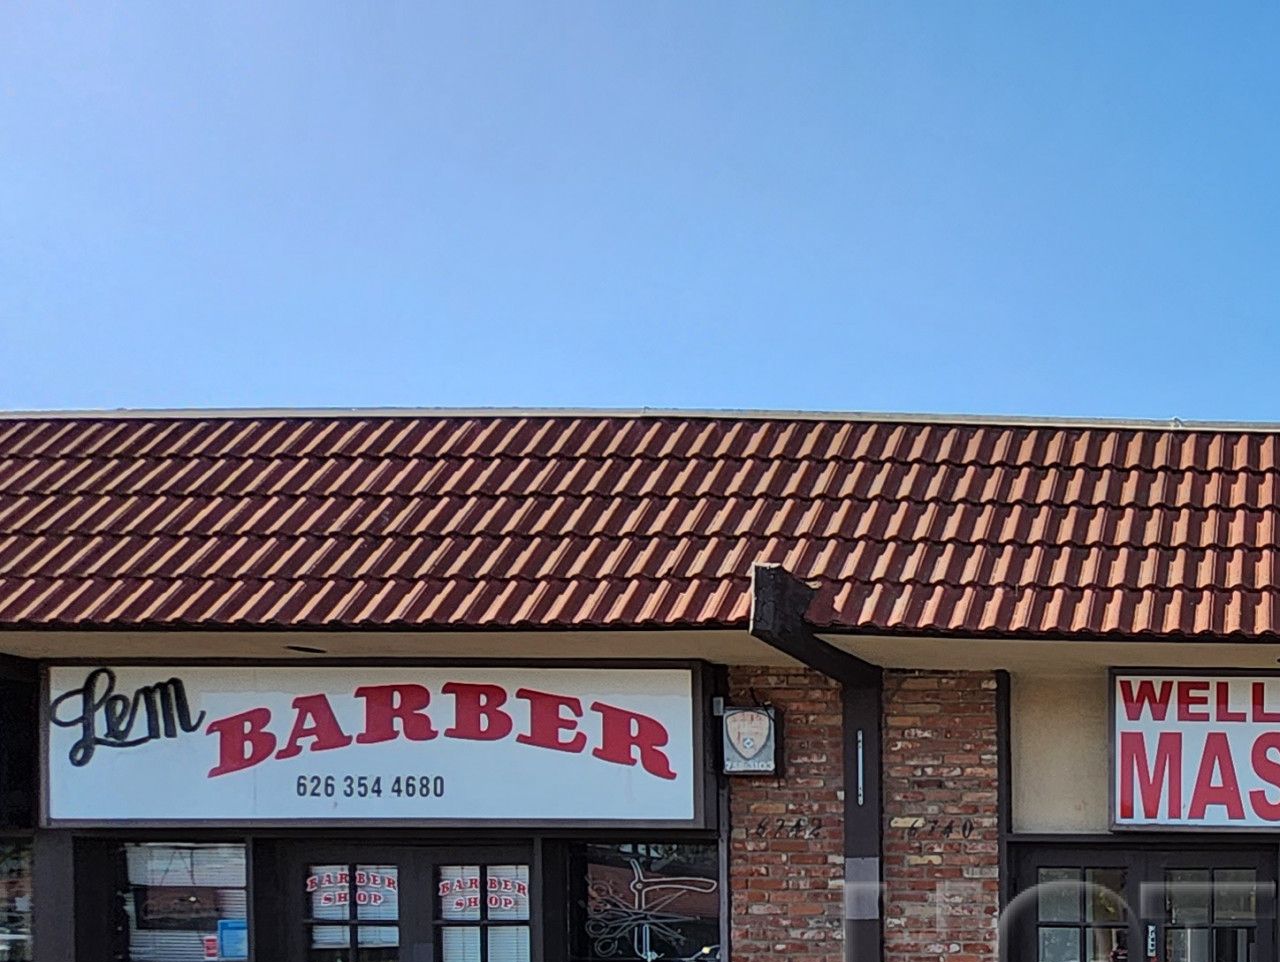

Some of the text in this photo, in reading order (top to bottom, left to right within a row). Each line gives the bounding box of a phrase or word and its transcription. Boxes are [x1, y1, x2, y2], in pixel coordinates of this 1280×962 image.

[50, 668, 677, 778] Lem BARBER
[296, 775, 445, 798] 626 354 4680
[756, 816, 823, 839] 6742
[908, 818, 973, 839] 6740
[306, 871, 398, 892] BARBER
[439, 876, 528, 897] BARBER
[320, 891, 384, 906] SHOP
[453, 896, 514, 911] SHOP
